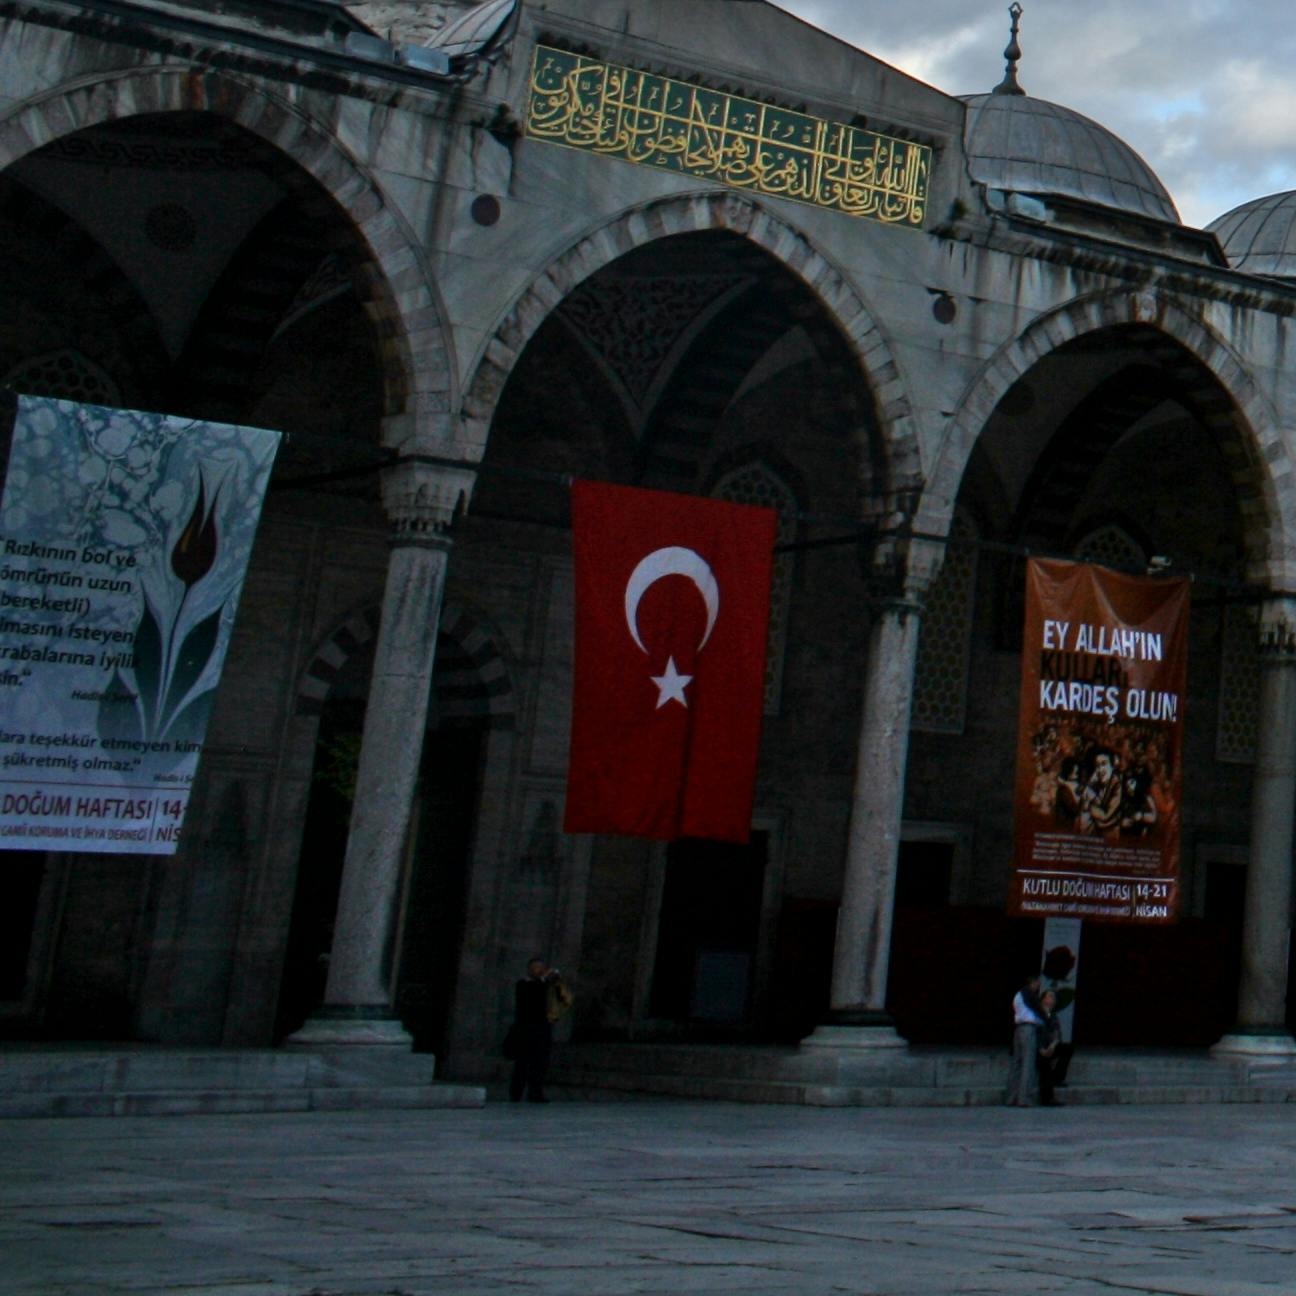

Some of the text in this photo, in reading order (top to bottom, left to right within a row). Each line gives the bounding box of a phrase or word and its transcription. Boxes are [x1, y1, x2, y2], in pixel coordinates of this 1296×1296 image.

[81, 547, 112, 567] bol
[116, 553, 137, 568] ve
[0, 567, 132, 593] ömrünün uzun
[1043, 619, 1162, 661] EY ALLAH'IN
[0, 645, 95, 667] rabalarına
[1040, 679, 1178, 724] KARDEŞ OLUN!
[30, 733, 96, 748] teşekkür
[101, 739, 170, 754] etmeyen
[3, 754, 79, 772] şükretmiş
[2, 791, 71, 816] DOĞUM
[76, 796, 152, 820] HAFTASI
[1023, 877, 1060, 896] KUTLU
[1136, 883, 1167, 900] 14-21
[1135, 903, 1167, 918] NİSAN
